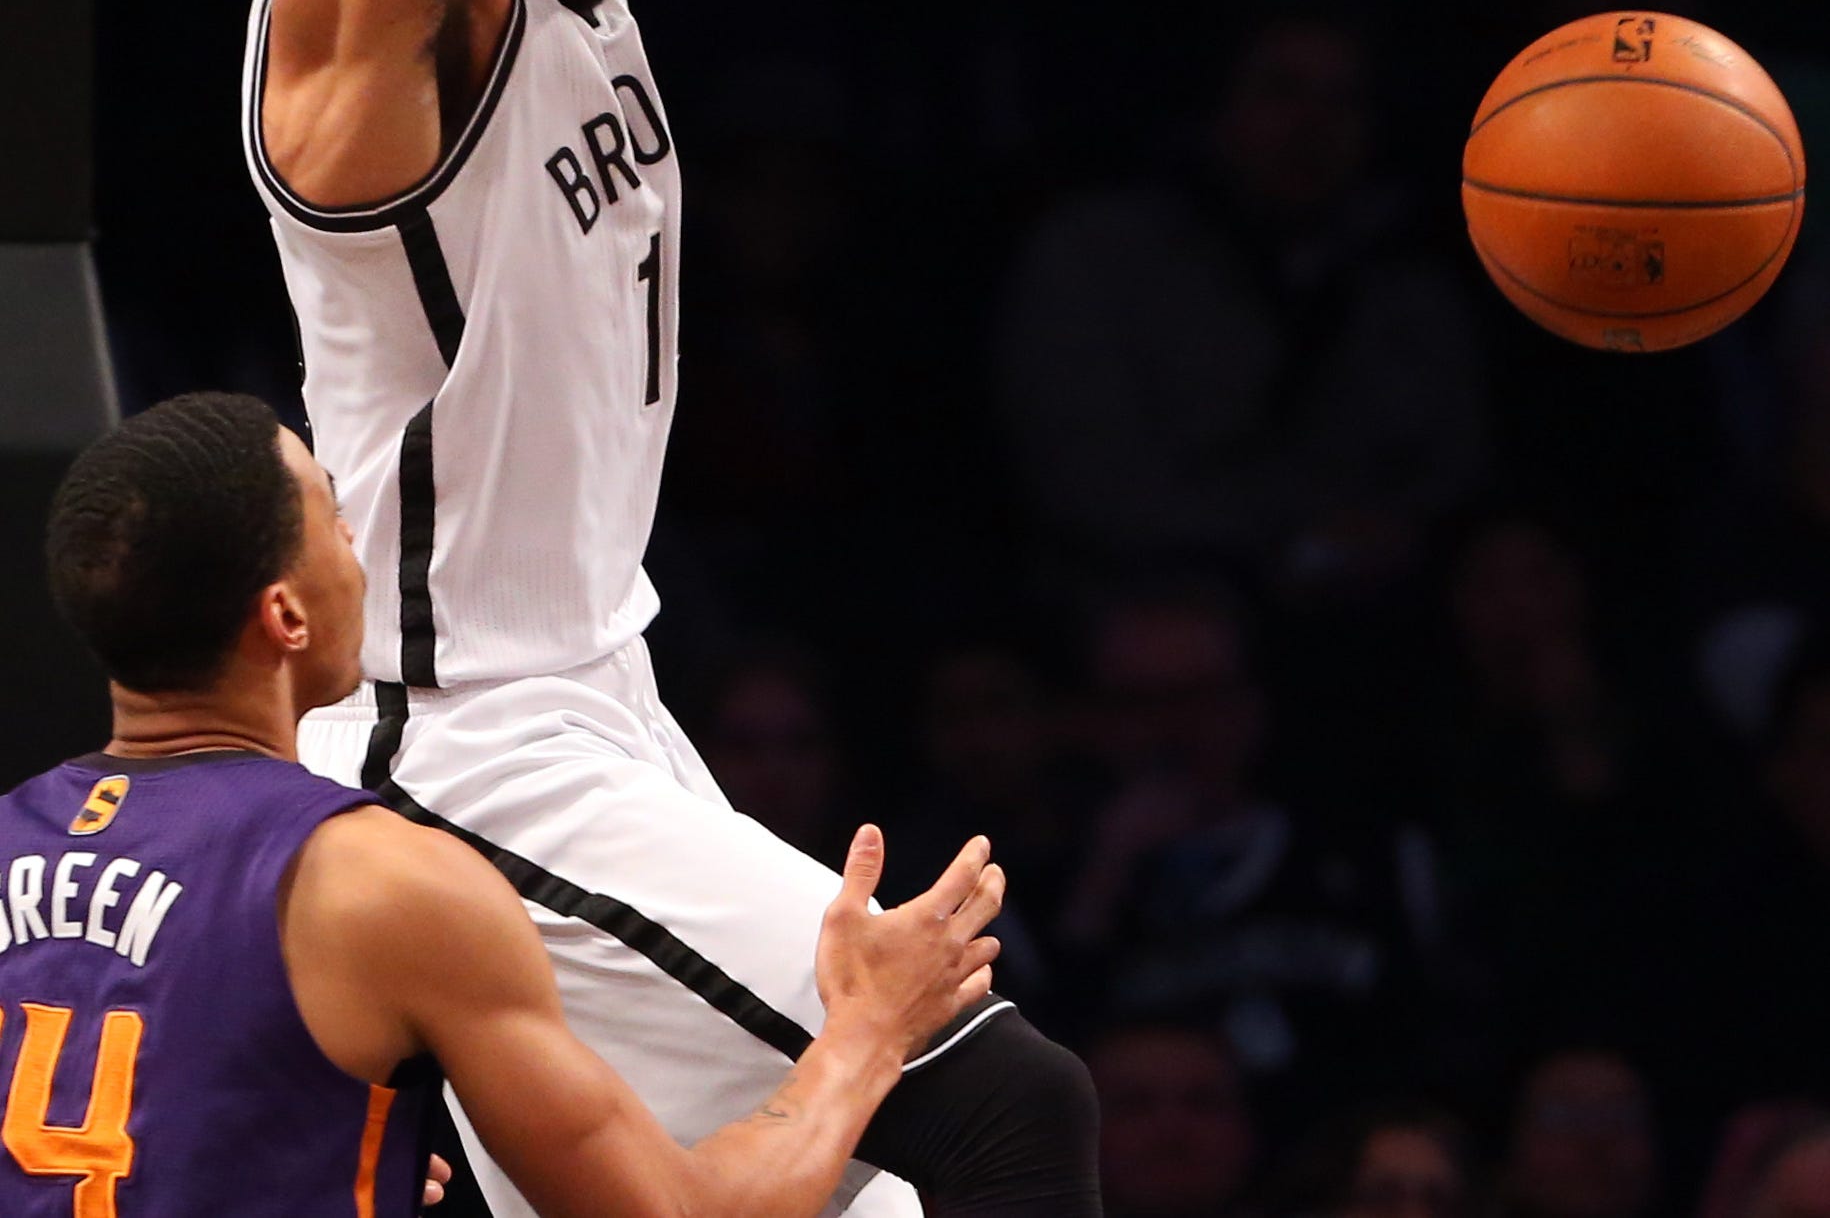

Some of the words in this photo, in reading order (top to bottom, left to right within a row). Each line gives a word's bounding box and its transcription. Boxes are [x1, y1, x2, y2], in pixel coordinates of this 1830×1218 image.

[545, 74, 671, 236] BRO
[638, 231, 661, 406] 1
[0, 851, 184, 968] REEN
[0, 1001, 144, 1218] 4
